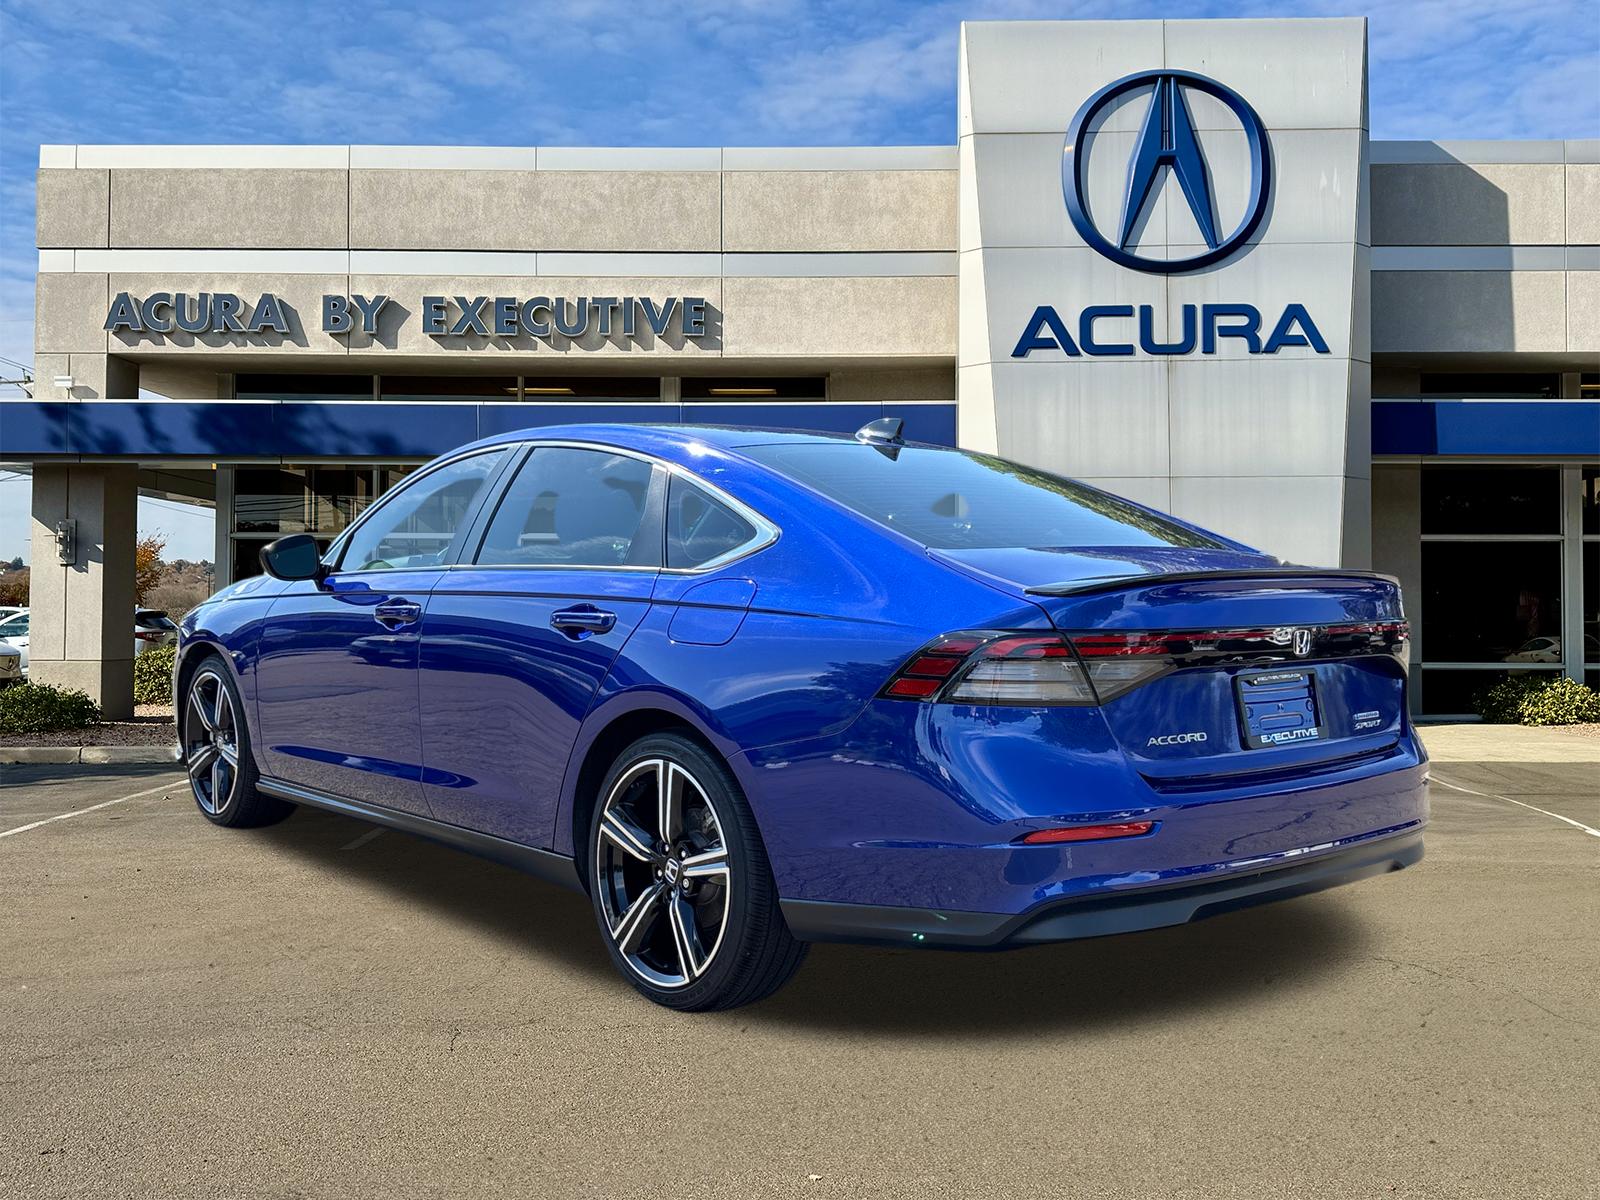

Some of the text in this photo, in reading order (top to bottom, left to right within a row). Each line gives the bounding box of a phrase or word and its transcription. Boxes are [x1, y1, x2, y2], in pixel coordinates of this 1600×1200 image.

[103, 292, 706, 337] ACURA BY EXECUTIVE
[1011, 303, 1332, 357] ACURA
[1354, 719, 1382, 730] SPORT
[1147, 732, 1208, 747] ACCORD
[1260, 727, 1319, 743] EXECUTIVE
